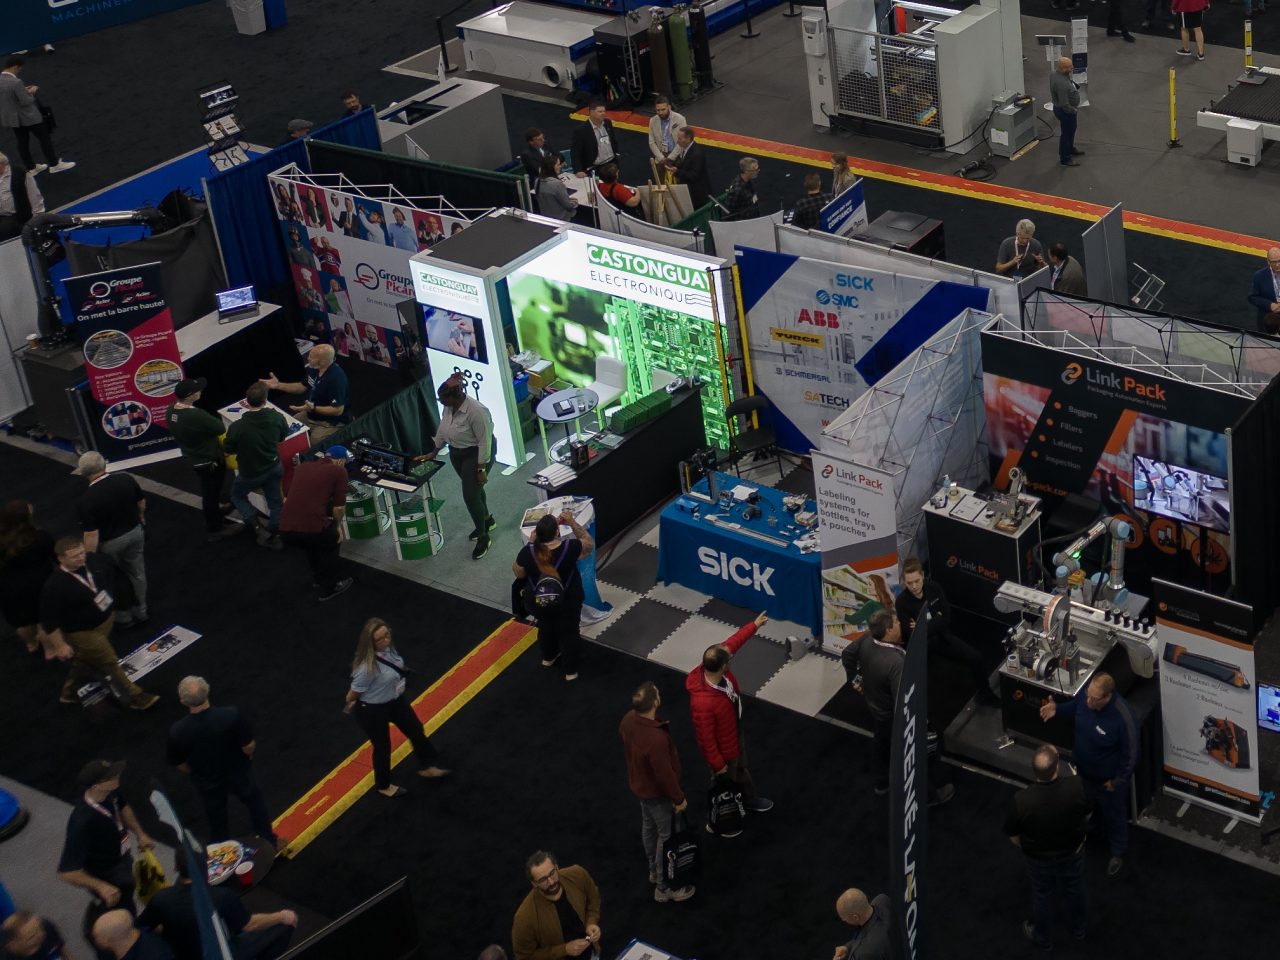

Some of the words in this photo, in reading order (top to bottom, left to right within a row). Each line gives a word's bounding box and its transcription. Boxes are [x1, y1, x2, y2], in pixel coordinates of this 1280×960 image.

[109, 276, 143, 288] Groupe
[386, 280, 416, 296] Picar
[420, 272, 478, 296] CASTONGUAY
[590, 270, 693, 304] ELECTRONIQUE
[835, 273, 874, 291] SICK
[76, 313, 90, 322] On
[91, 310, 107, 320] met
[107, 308, 116, 317] la
[116, 304, 138, 315] barre
[139, 299, 165, 311] haute!
[831, 294, 859, 309] SMC
[798, 308, 840, 330] ABB
[775, 331, 820, 345] TURCK
[784, 369, 832, 384] SCHMERSAL
[1086, 367, 1121, 389] Link
[1124, 376, 1167, 401] Pack
[804, 391, 850, 408] SATECH
[1068, 405, 1098, 420] Baggers
[1060, 421, 1083, 434] Fillers
[1053, 438, 1084, 453] Labelers
[1045, 454, 1081, 470] Inspection
[836, 468, 857, 481] Link
[858, 473, 883, 490] Pack
[819, 487, 856, 506] Labeling
[819, 500, 856, 515] systems
[858, 507, 870, 519] for
[820, 509, 850, 524] bottles,
[854, 517, 876, 531] trays
[821, 518, 827, 526] &
[829, 521, 867, 538] pouches
[698, 546, 775, 596] SICK
[958, 559, 976, 570] Link
[977, 564, 999, 580] Pack
